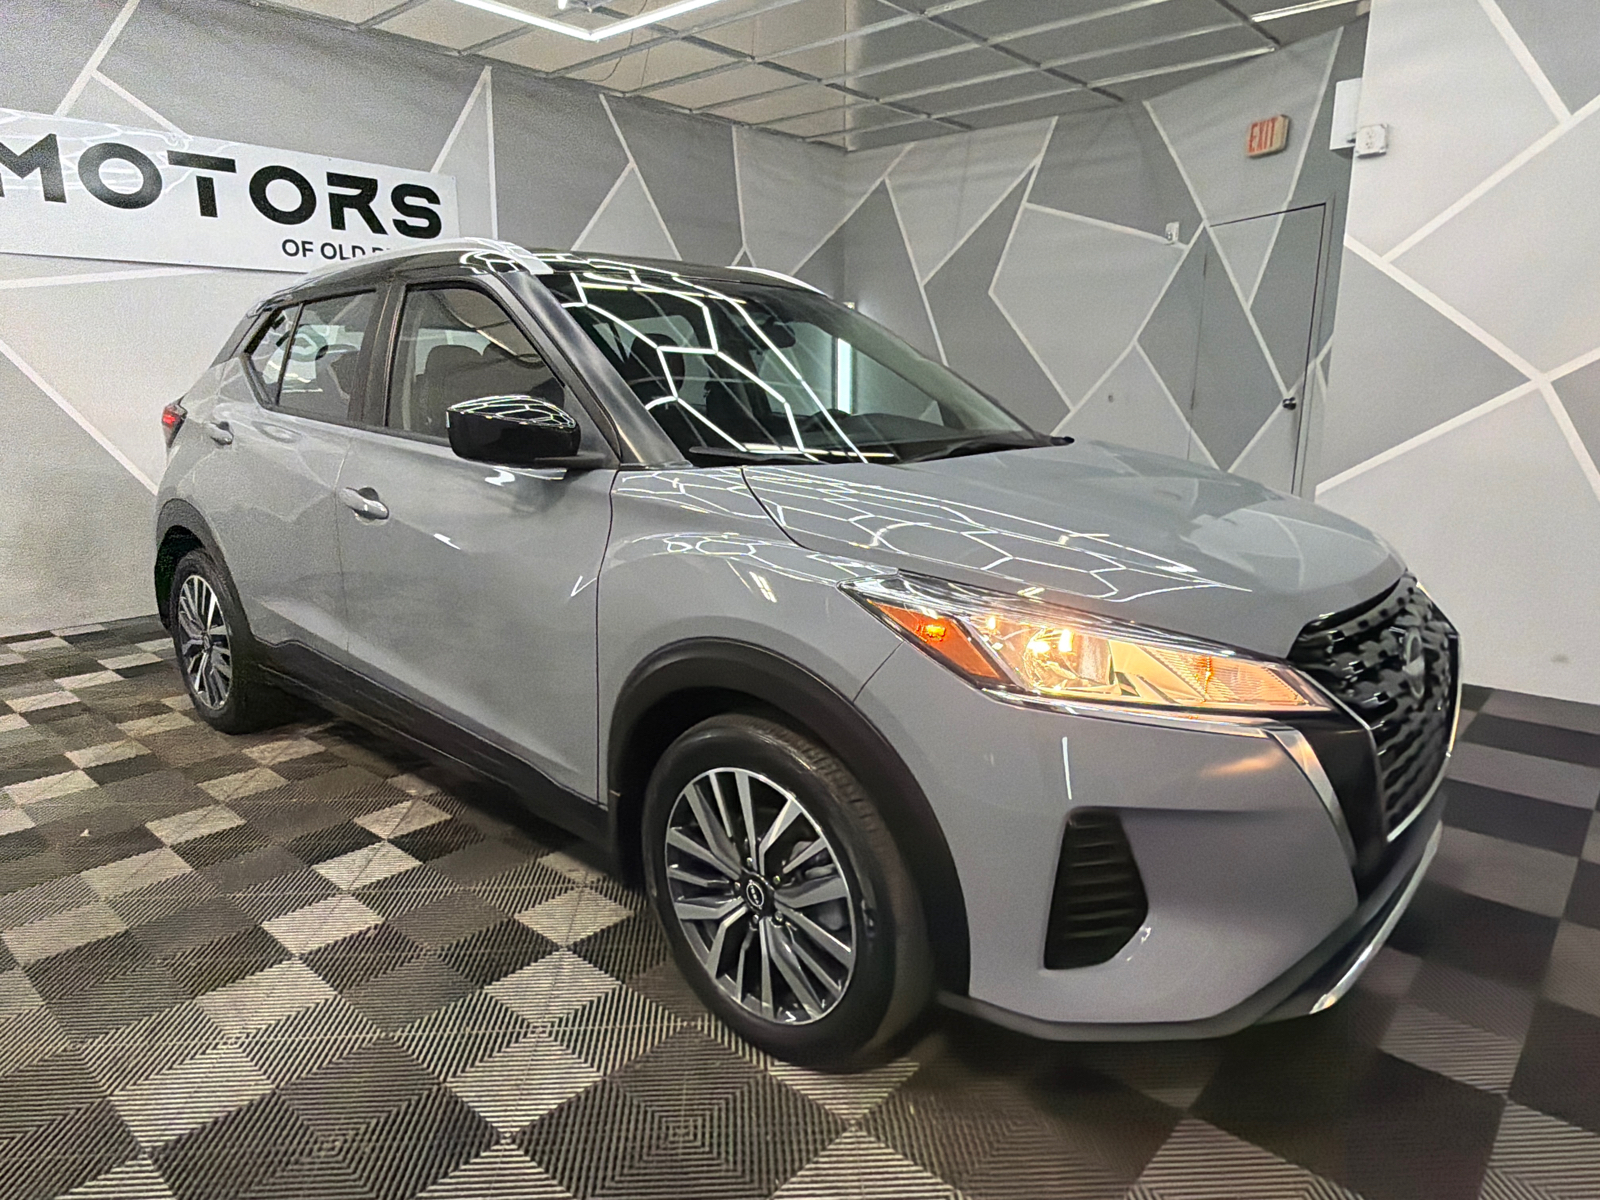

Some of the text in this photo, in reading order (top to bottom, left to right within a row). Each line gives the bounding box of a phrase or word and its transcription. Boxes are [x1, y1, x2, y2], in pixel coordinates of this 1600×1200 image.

[1248, 116, 1279, 153] EXIT
[0, 133, 442, 239] MOTORS
[281, 239, 314, 258] OF
[320, 242, 366, 261] OLD
